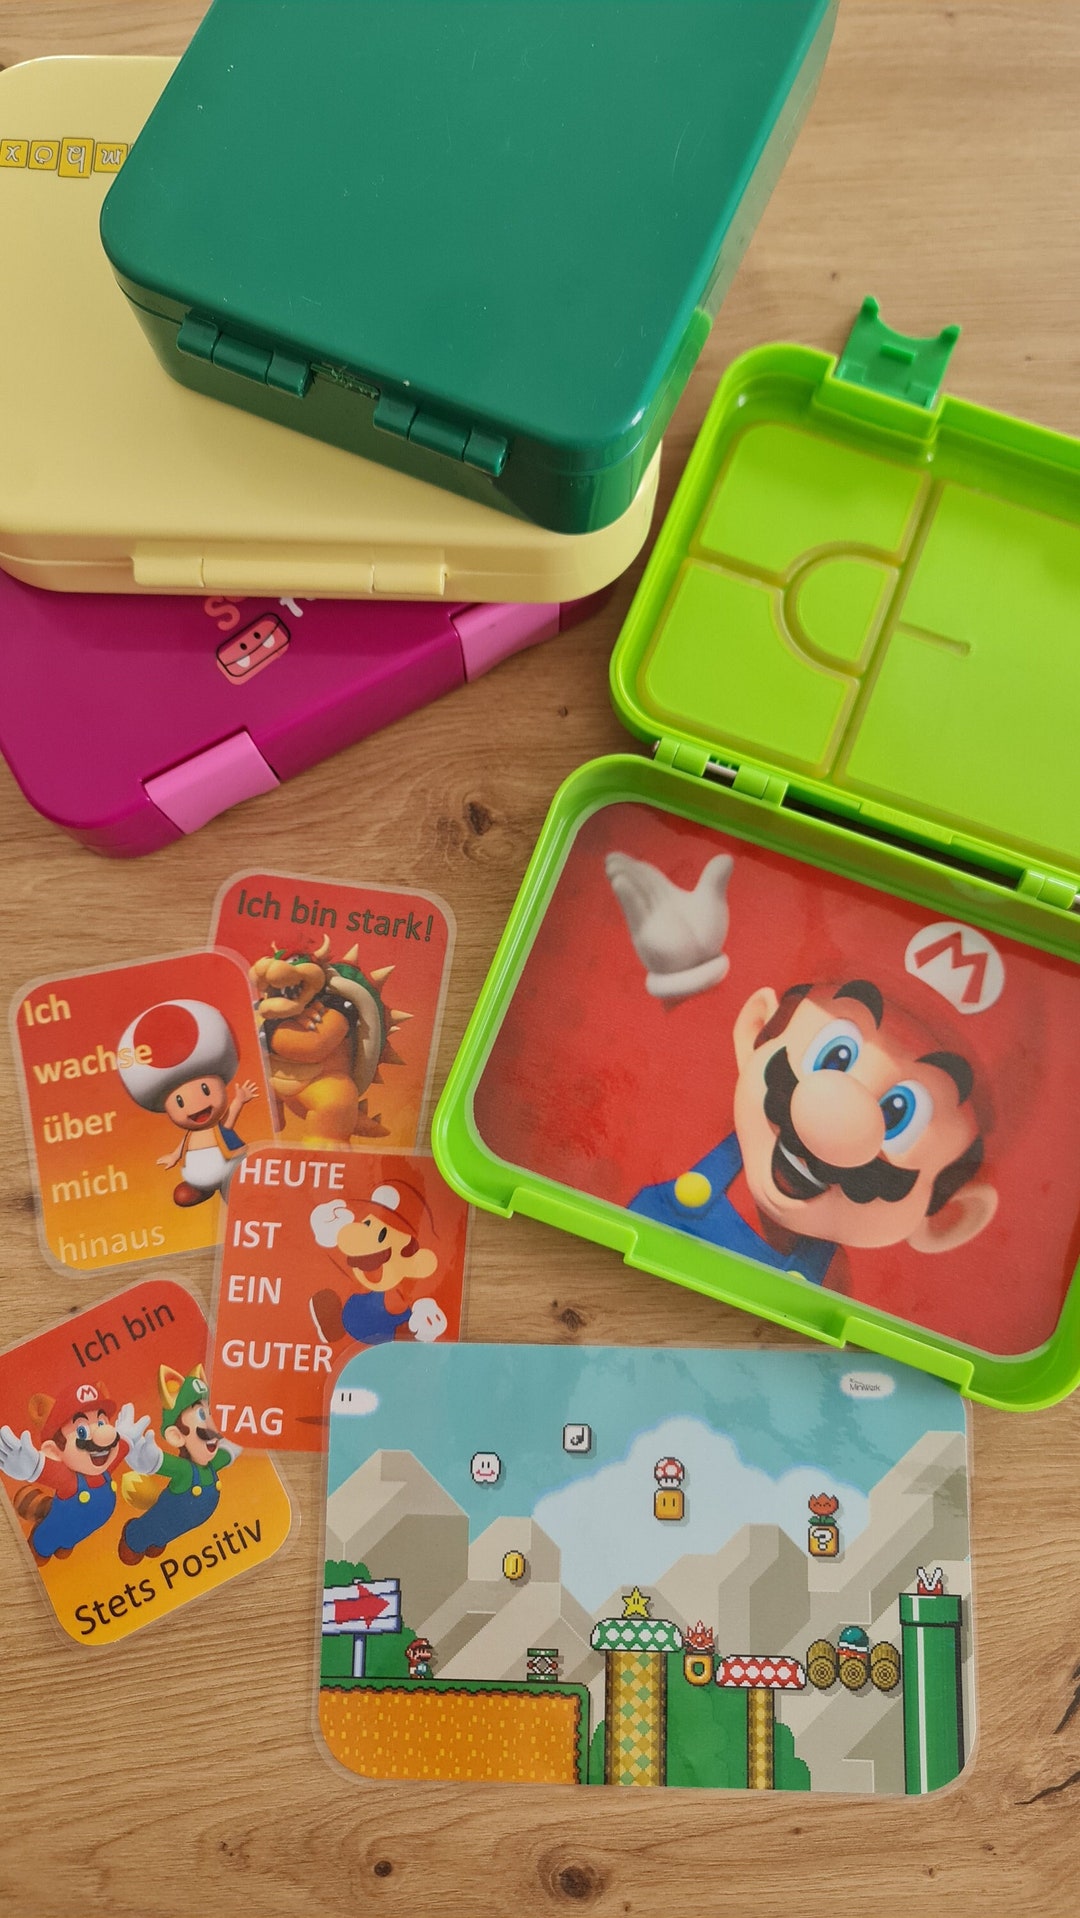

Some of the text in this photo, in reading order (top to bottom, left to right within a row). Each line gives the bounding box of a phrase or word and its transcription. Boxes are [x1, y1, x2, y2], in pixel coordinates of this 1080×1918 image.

[5, 145, 126, 174] mbox
[237, 889, 434, 942] Ich bin stark!
[914, 930, 988, 1004] M
[23, 993, 71, 1026] Ich
[33, 1043, 153, 1084] wachse
[43, 1110, 117, 1143] über
[51, 1164, 128, 1204] mich
[239, 1157, 346, 1190] HEUTE
[58, 1225, 165, 1264] hinaus
[233, 1220, 282, 1249] IST
[228, 1274, 282, 1305] EIN
[71, 1304, 175, 1368] Ich bin
[221, 1339, 333, 1373] GUTER
[79, 1386, 97, 1401] M
[215, 1403, 284, 1436] TAG
[74, 1519, 262, 1636] Stets Positiv
